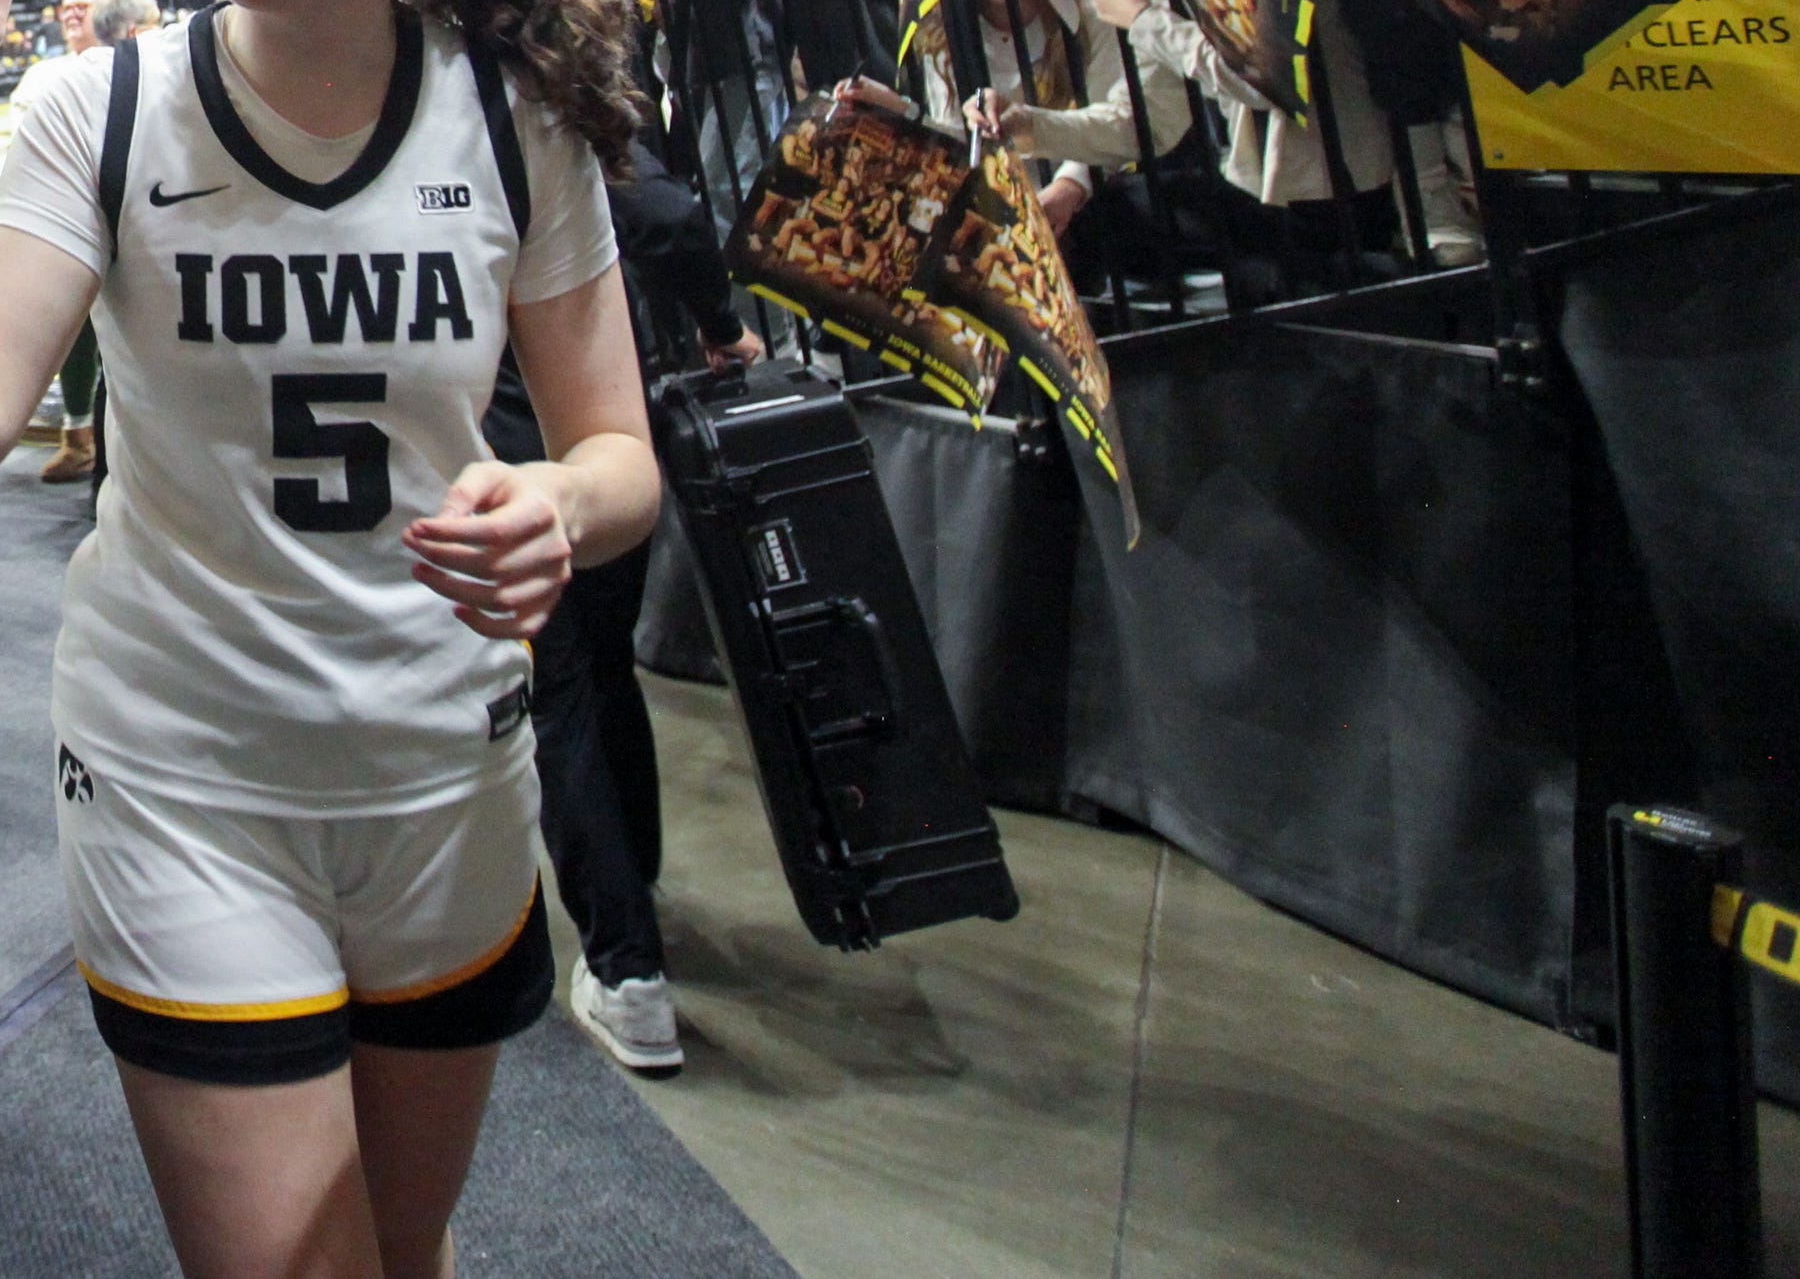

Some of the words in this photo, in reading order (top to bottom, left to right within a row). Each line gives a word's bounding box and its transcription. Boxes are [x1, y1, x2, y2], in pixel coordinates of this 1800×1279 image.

[1643, 16, 1791, 47] CLEARS
[1609, 65, 1714, 92] AREA
[175, 252, 474, 344] IOWA
[888, 333, 921, 359] IOWA
[272, 374, 392, 532] 5
